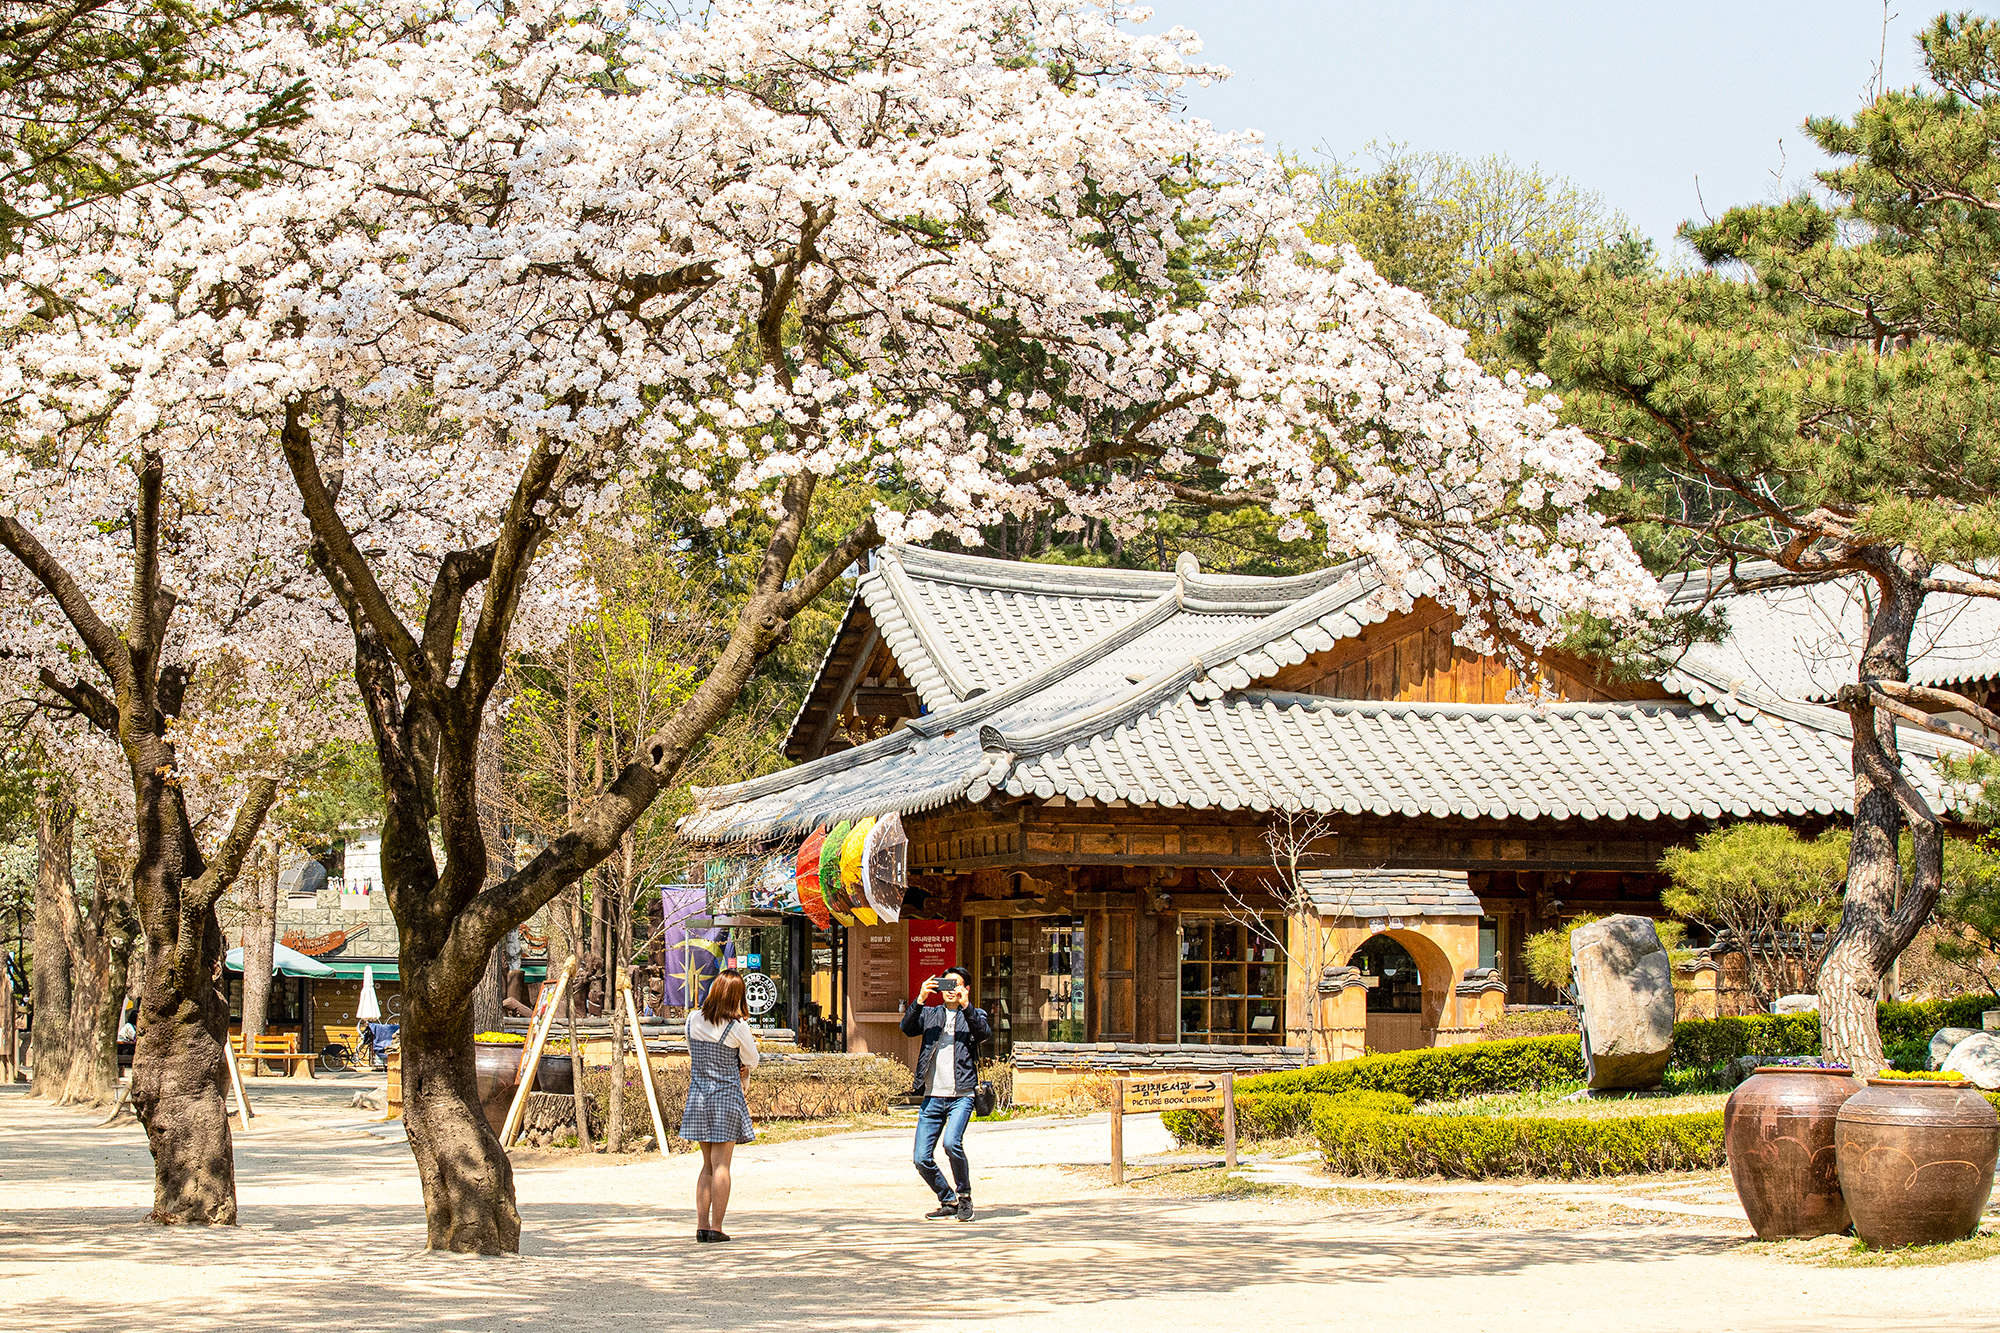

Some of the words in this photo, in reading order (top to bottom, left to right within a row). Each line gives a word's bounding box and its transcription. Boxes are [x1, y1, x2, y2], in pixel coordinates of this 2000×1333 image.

[1131, 1082, 1192, 1096] 그림책도서관
[1132, 1097, 1162, 1106] PICTURE
[1186, 1096, 1216, 1104] LIBRARY
